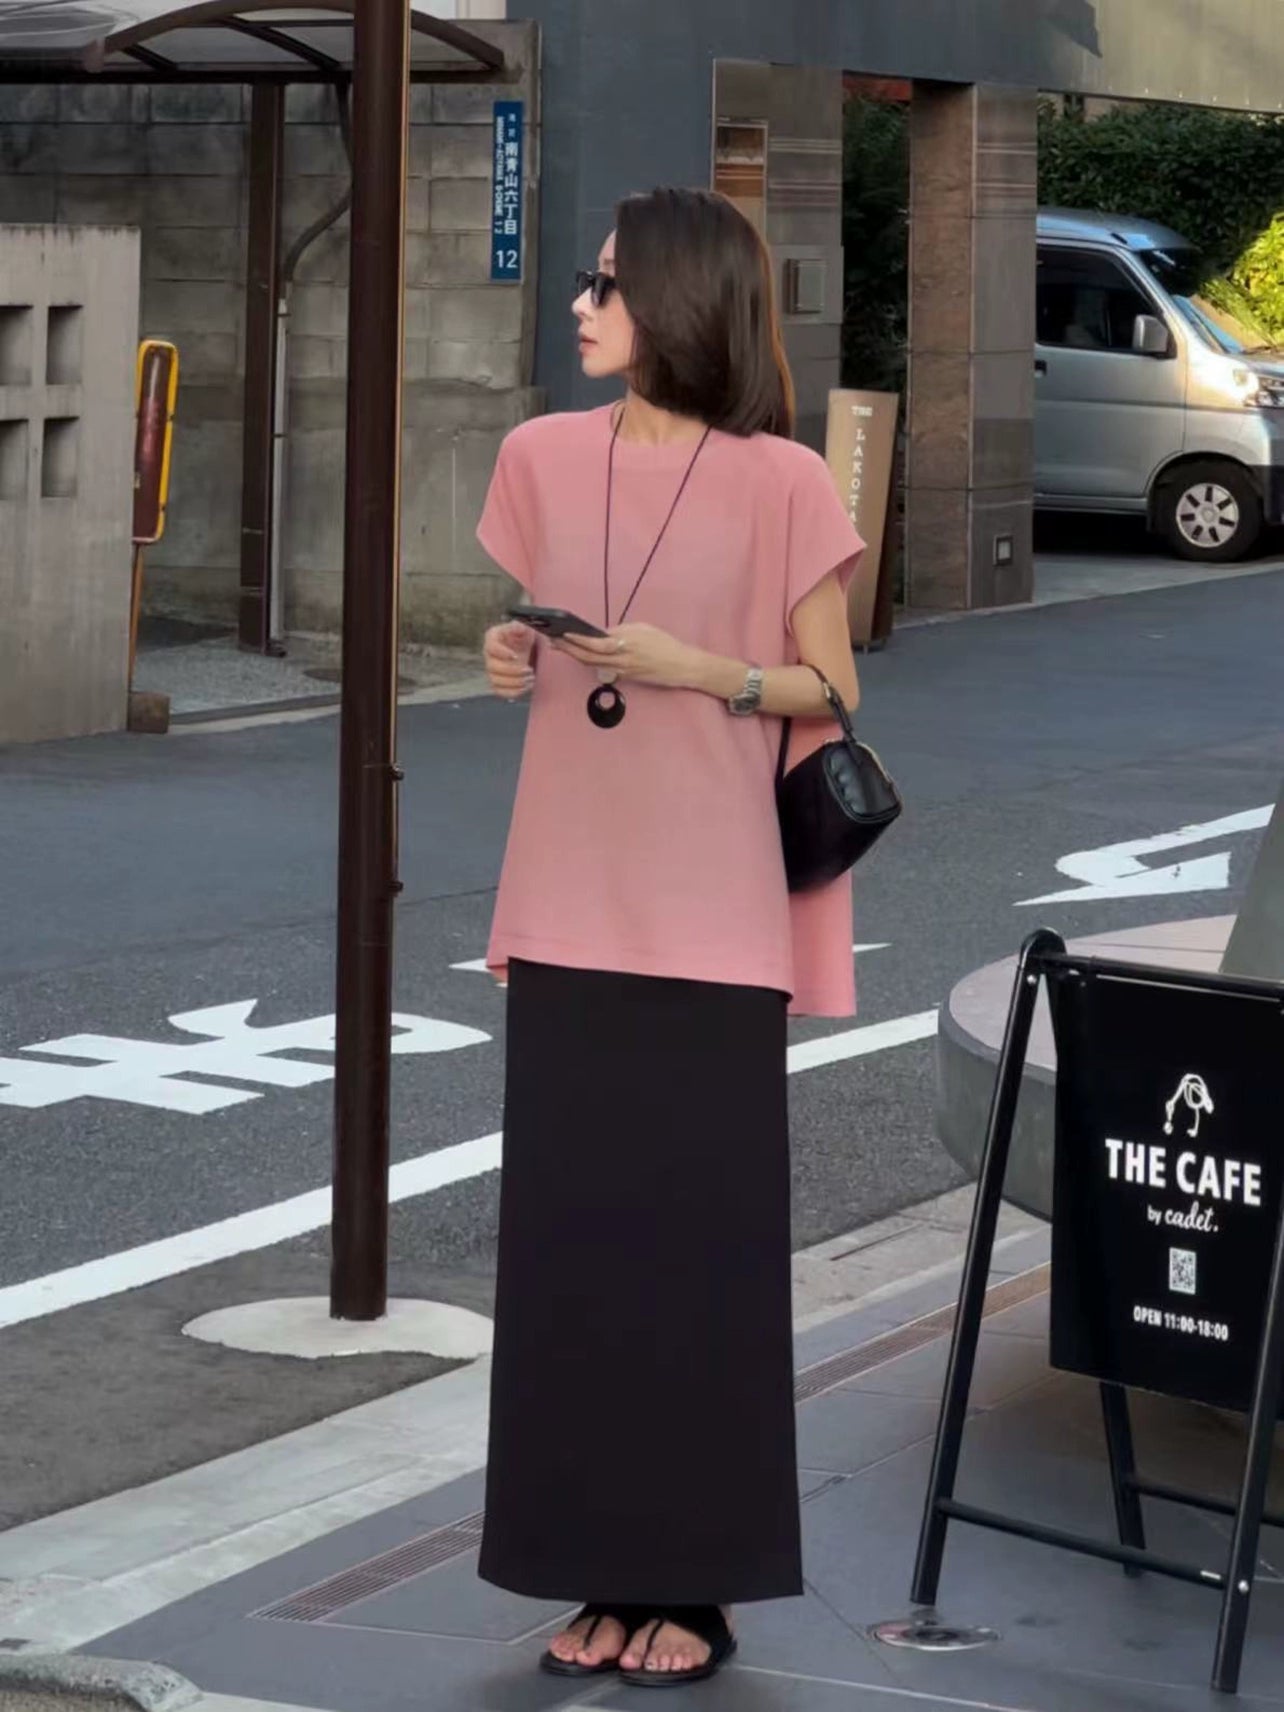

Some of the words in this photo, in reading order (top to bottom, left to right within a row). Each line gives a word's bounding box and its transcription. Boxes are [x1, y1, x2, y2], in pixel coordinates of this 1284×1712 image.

[504, 142, 519, 235] 南青山六丁目
[496, 249, 519, 269] 12
[1105, 1137, 1167, 1189] THE
[1175, 1151, 1262, 1207] CAFE
[1147, 1204, 1162, 1225] by
[1133, 1305, 1162, 1327] OPEN
[1164, 1312, 1229, 1341] 11:00-18:00
